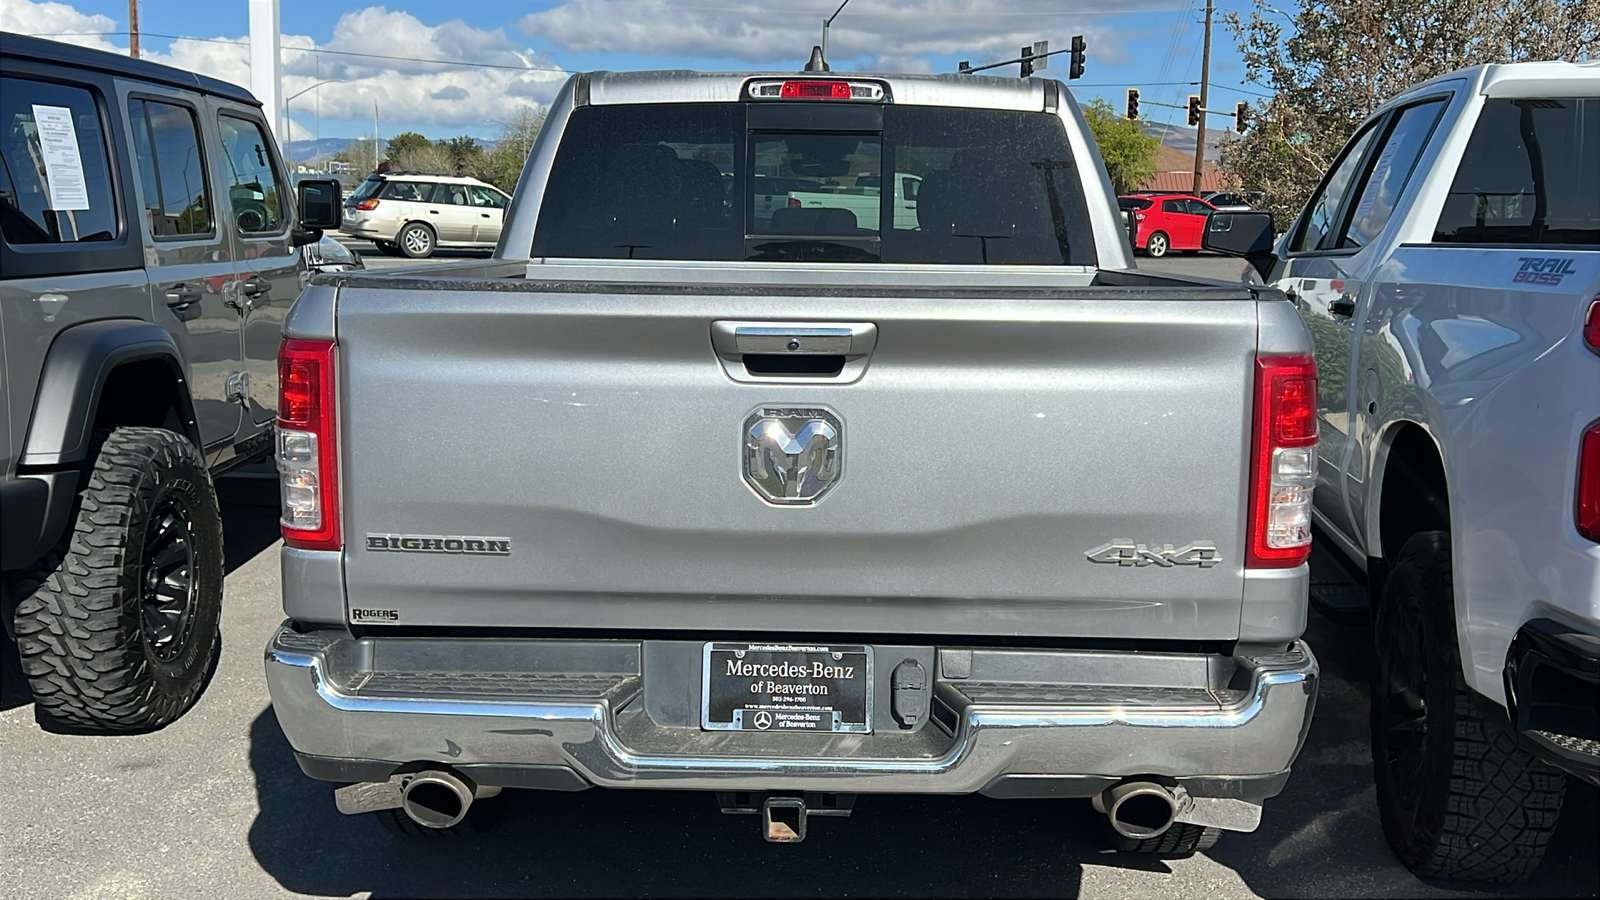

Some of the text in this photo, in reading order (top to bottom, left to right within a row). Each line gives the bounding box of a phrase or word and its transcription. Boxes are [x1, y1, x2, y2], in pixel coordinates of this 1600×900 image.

[1518, 257, 1577, 275] TRAIL
[1511, 271, 1564, 286] BOSS
[761, 407, 824, 419] RAM
[365, 532, 512, 556] BIGHORN
[725, 659, 854, 679] Mercedes-Benz
[750, 681, 828, 695] of Beaverton
[775, 712, 821, 722] Mercedes-Benz
